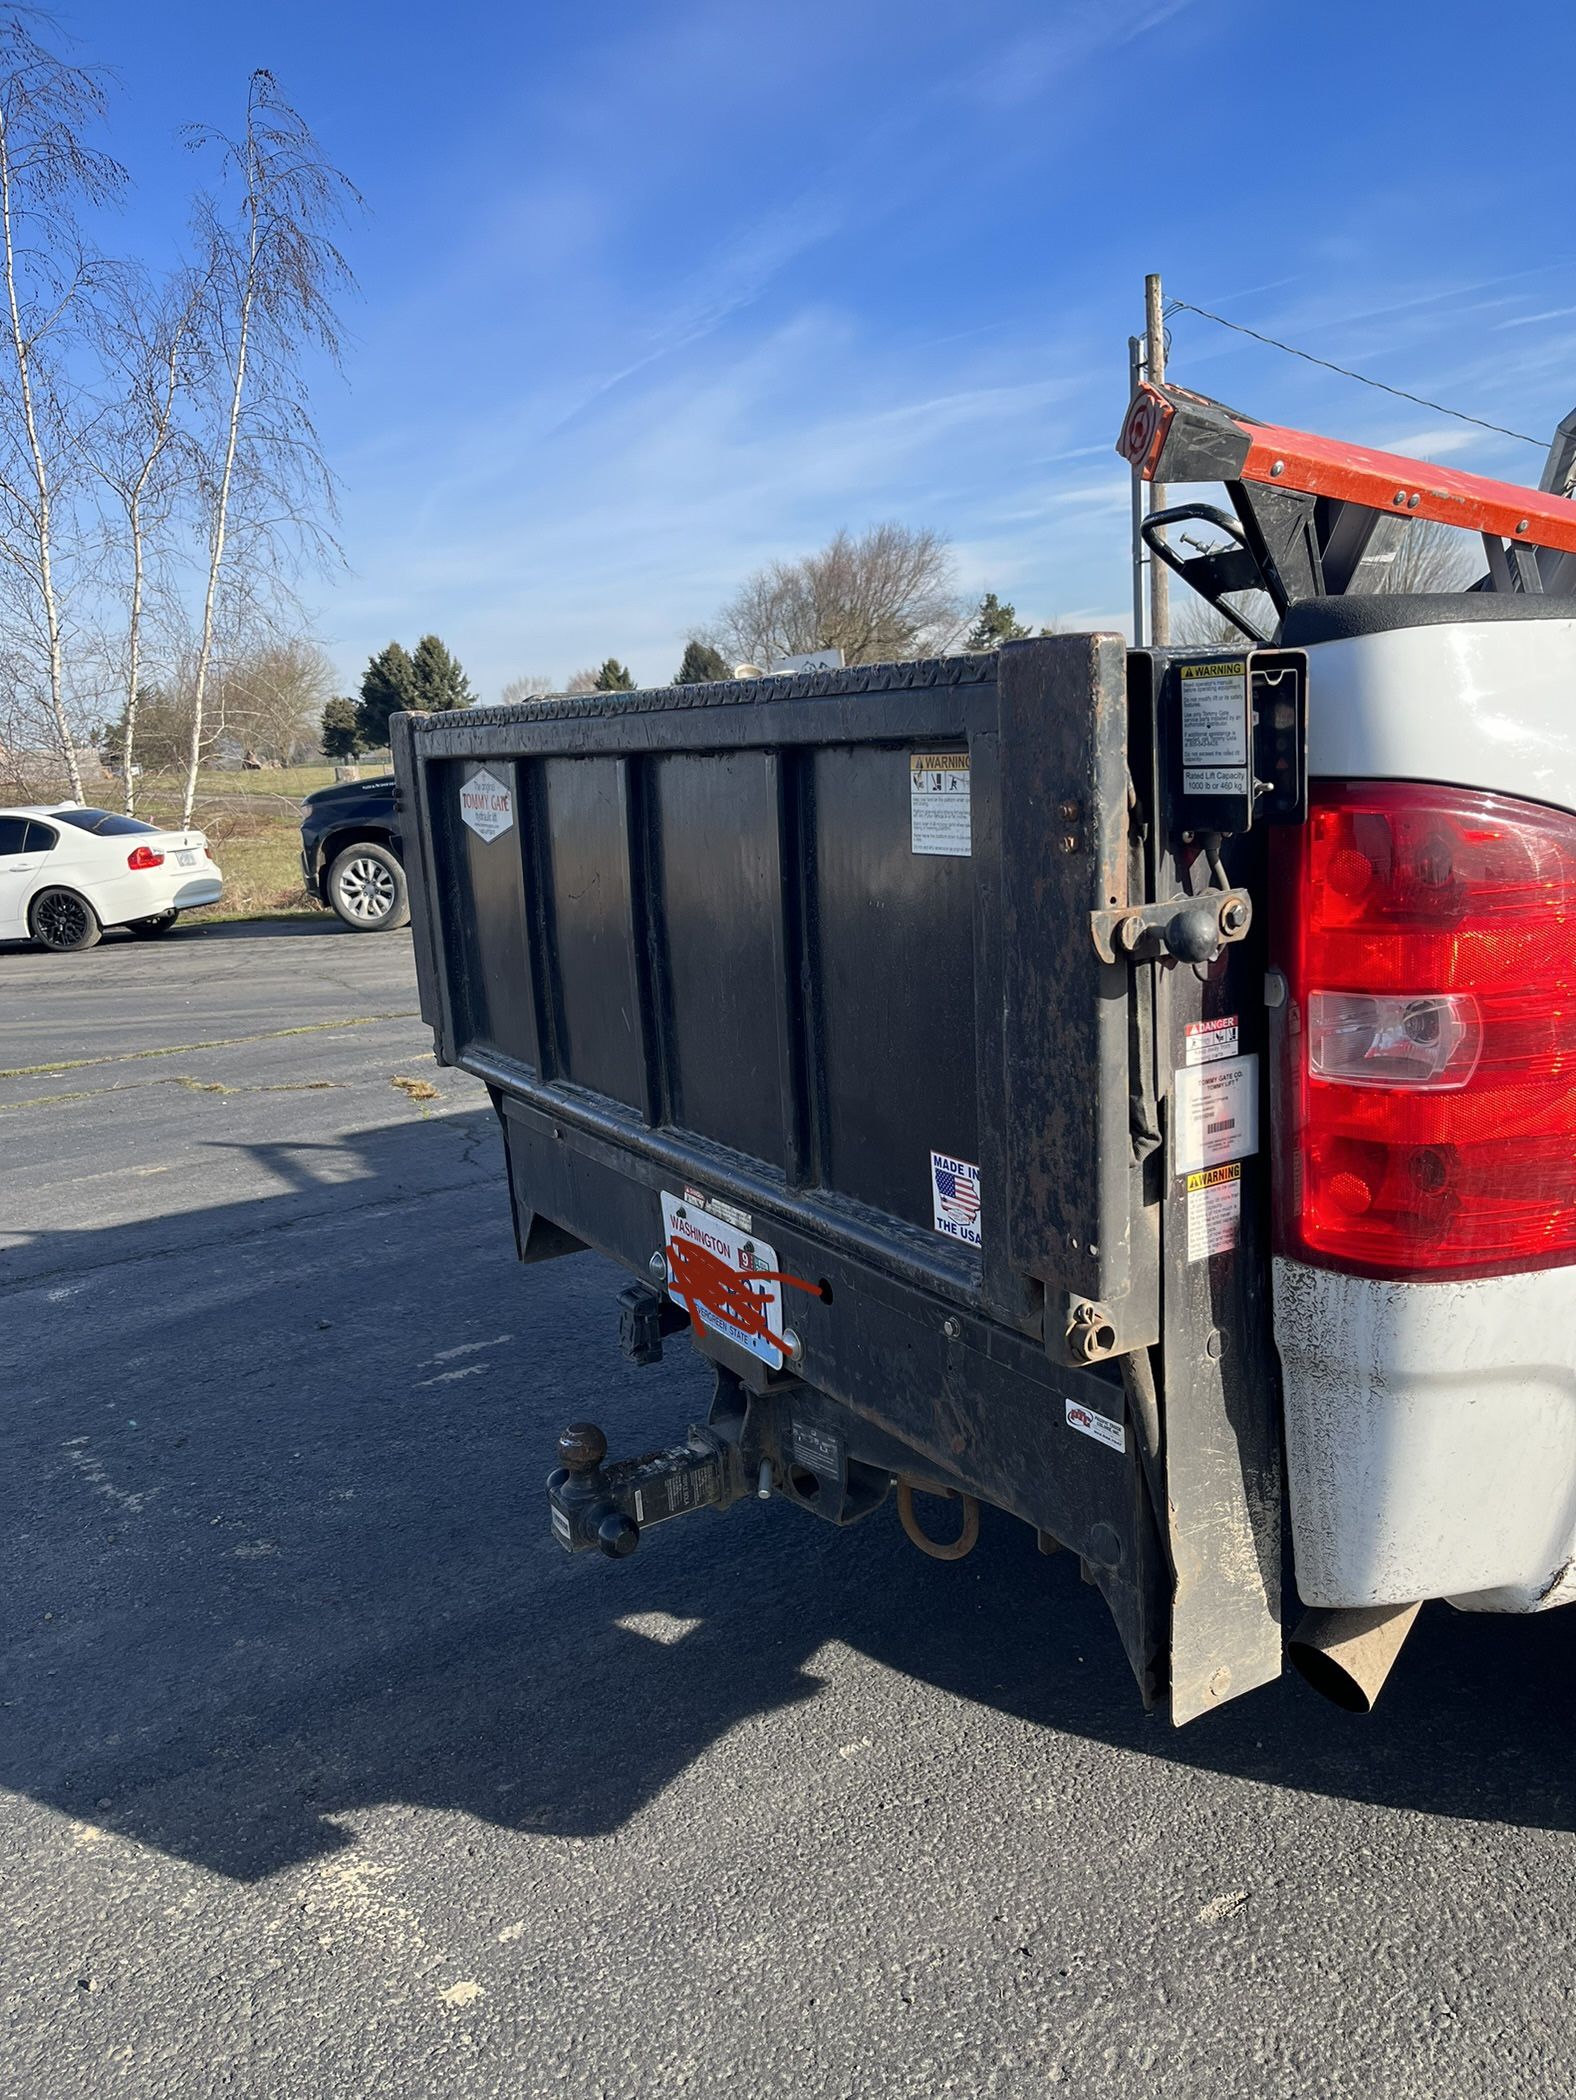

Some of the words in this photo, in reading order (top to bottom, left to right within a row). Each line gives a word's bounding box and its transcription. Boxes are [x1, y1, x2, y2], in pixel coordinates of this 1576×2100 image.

[1195, 663, 1241, 677] WARNING
[1185, 772, 1204, 780] Rated
[1205, 772, 1216, 780] Lift
[1216, 771, 1245, 781] Capacity
[1189, 781, 1204, 790] 1000
[1205, 781, 1211, 790] lb
[1234, 782, 1243, 791] kg
[463, 793, 489, 809] TOMMY
[1198, 1017, 1235, 1033] DANGER
[1198, 1076, 1217, 1086] TOMMY
[1218, 1072, 1233, 1082] GATE
[1233, 1070, 1243, 1078] CO.
[1207, 1082, 1224, 1091] TOMMY
[1224, 1079, 1235, 1088] LIFT
[933, 1155, 965, 1175] MADE
[968, 1167, 980, 1181] IN
[1198, 1164, 1240, 1186] WARNING
[670, 1214, 731, 1259] WASHINGTON
[936, 1217, 957, 1235] THE
[960, 1226, 982, 1245] USA
[742, 1251, 749, 1266] 9
[694, 1303, 728, 1332] VERGREEN
[729, 1325, 749, 1346] STATE
